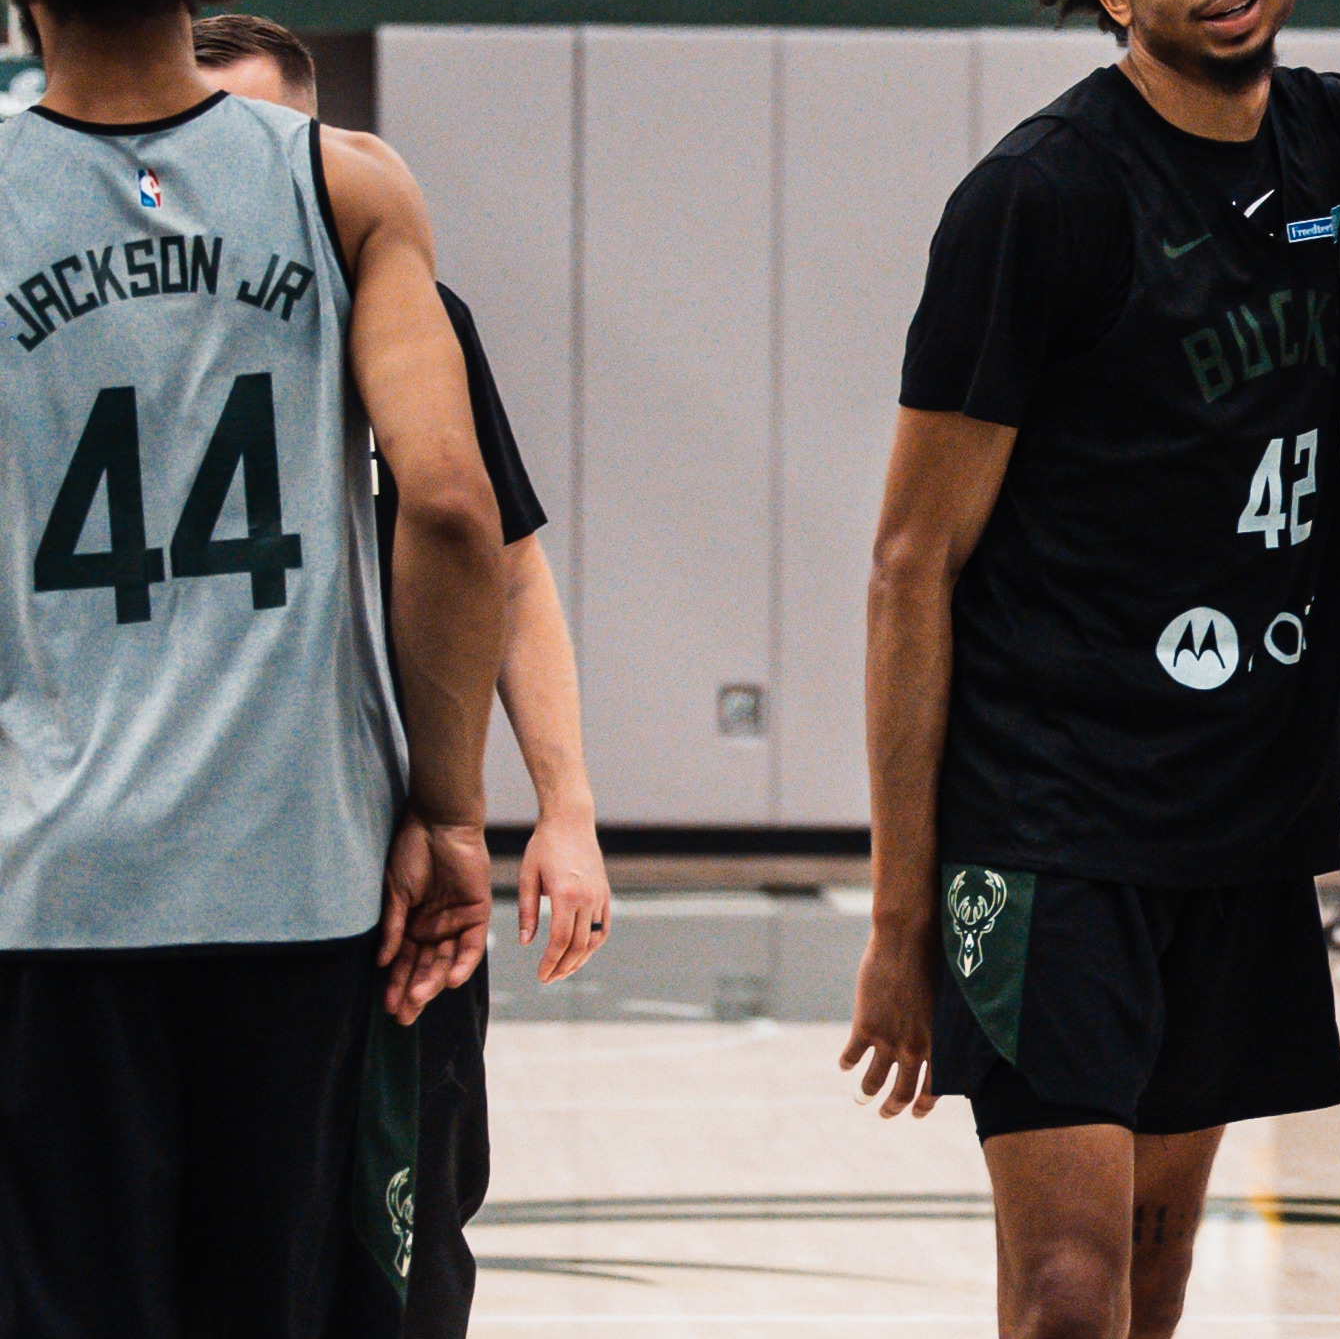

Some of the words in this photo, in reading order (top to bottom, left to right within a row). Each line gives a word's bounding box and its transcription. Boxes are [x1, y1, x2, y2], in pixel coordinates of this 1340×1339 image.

[5, 235, 223, 352] JACKSON
[237, 254, 314, 322] JR
[1181, 288, 1337, 404] BUCK
[34, 371, 303, 625] 44
[1237, 429, 1318, 549] 42
